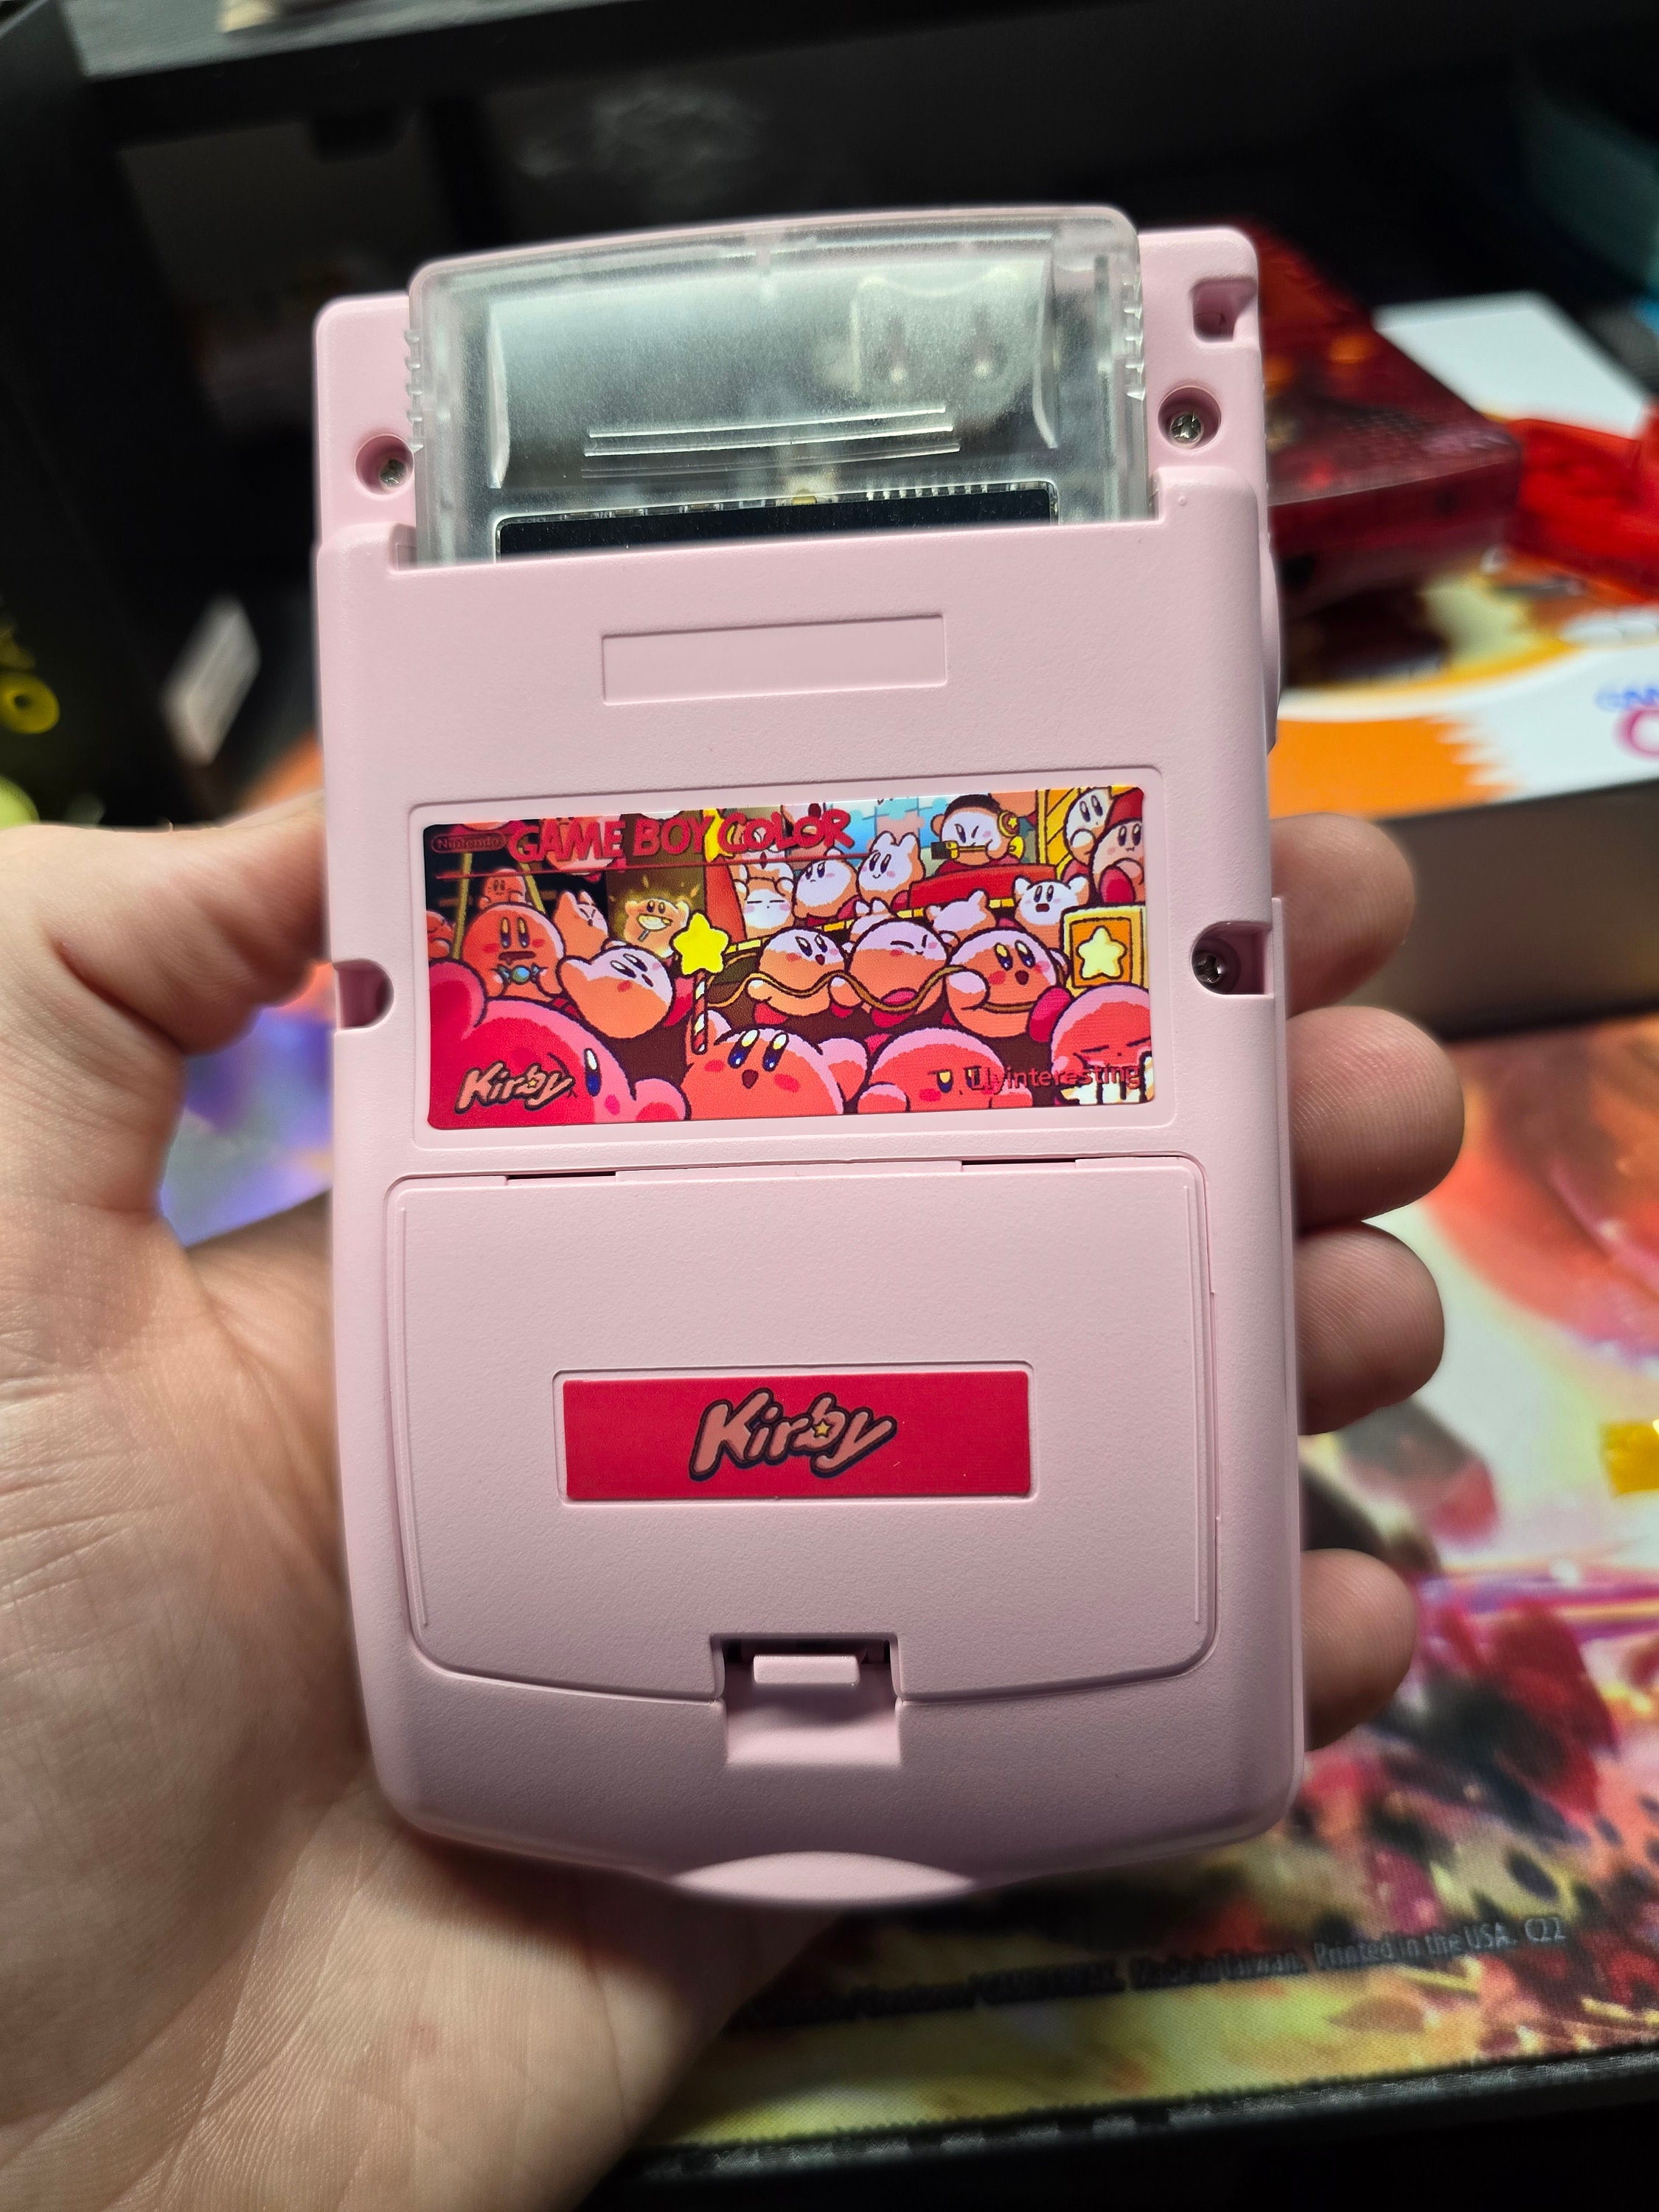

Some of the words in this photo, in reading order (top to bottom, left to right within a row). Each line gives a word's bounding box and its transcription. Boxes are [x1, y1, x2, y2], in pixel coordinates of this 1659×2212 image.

[508, 818, 625, 863] GAME
[634, 815, 714, 856] BOY
[717, 808, 855, 852] COLOR
[455, 1060, 575, 1113] Kirby
[689, 1387, 897, 1482] Kirby
